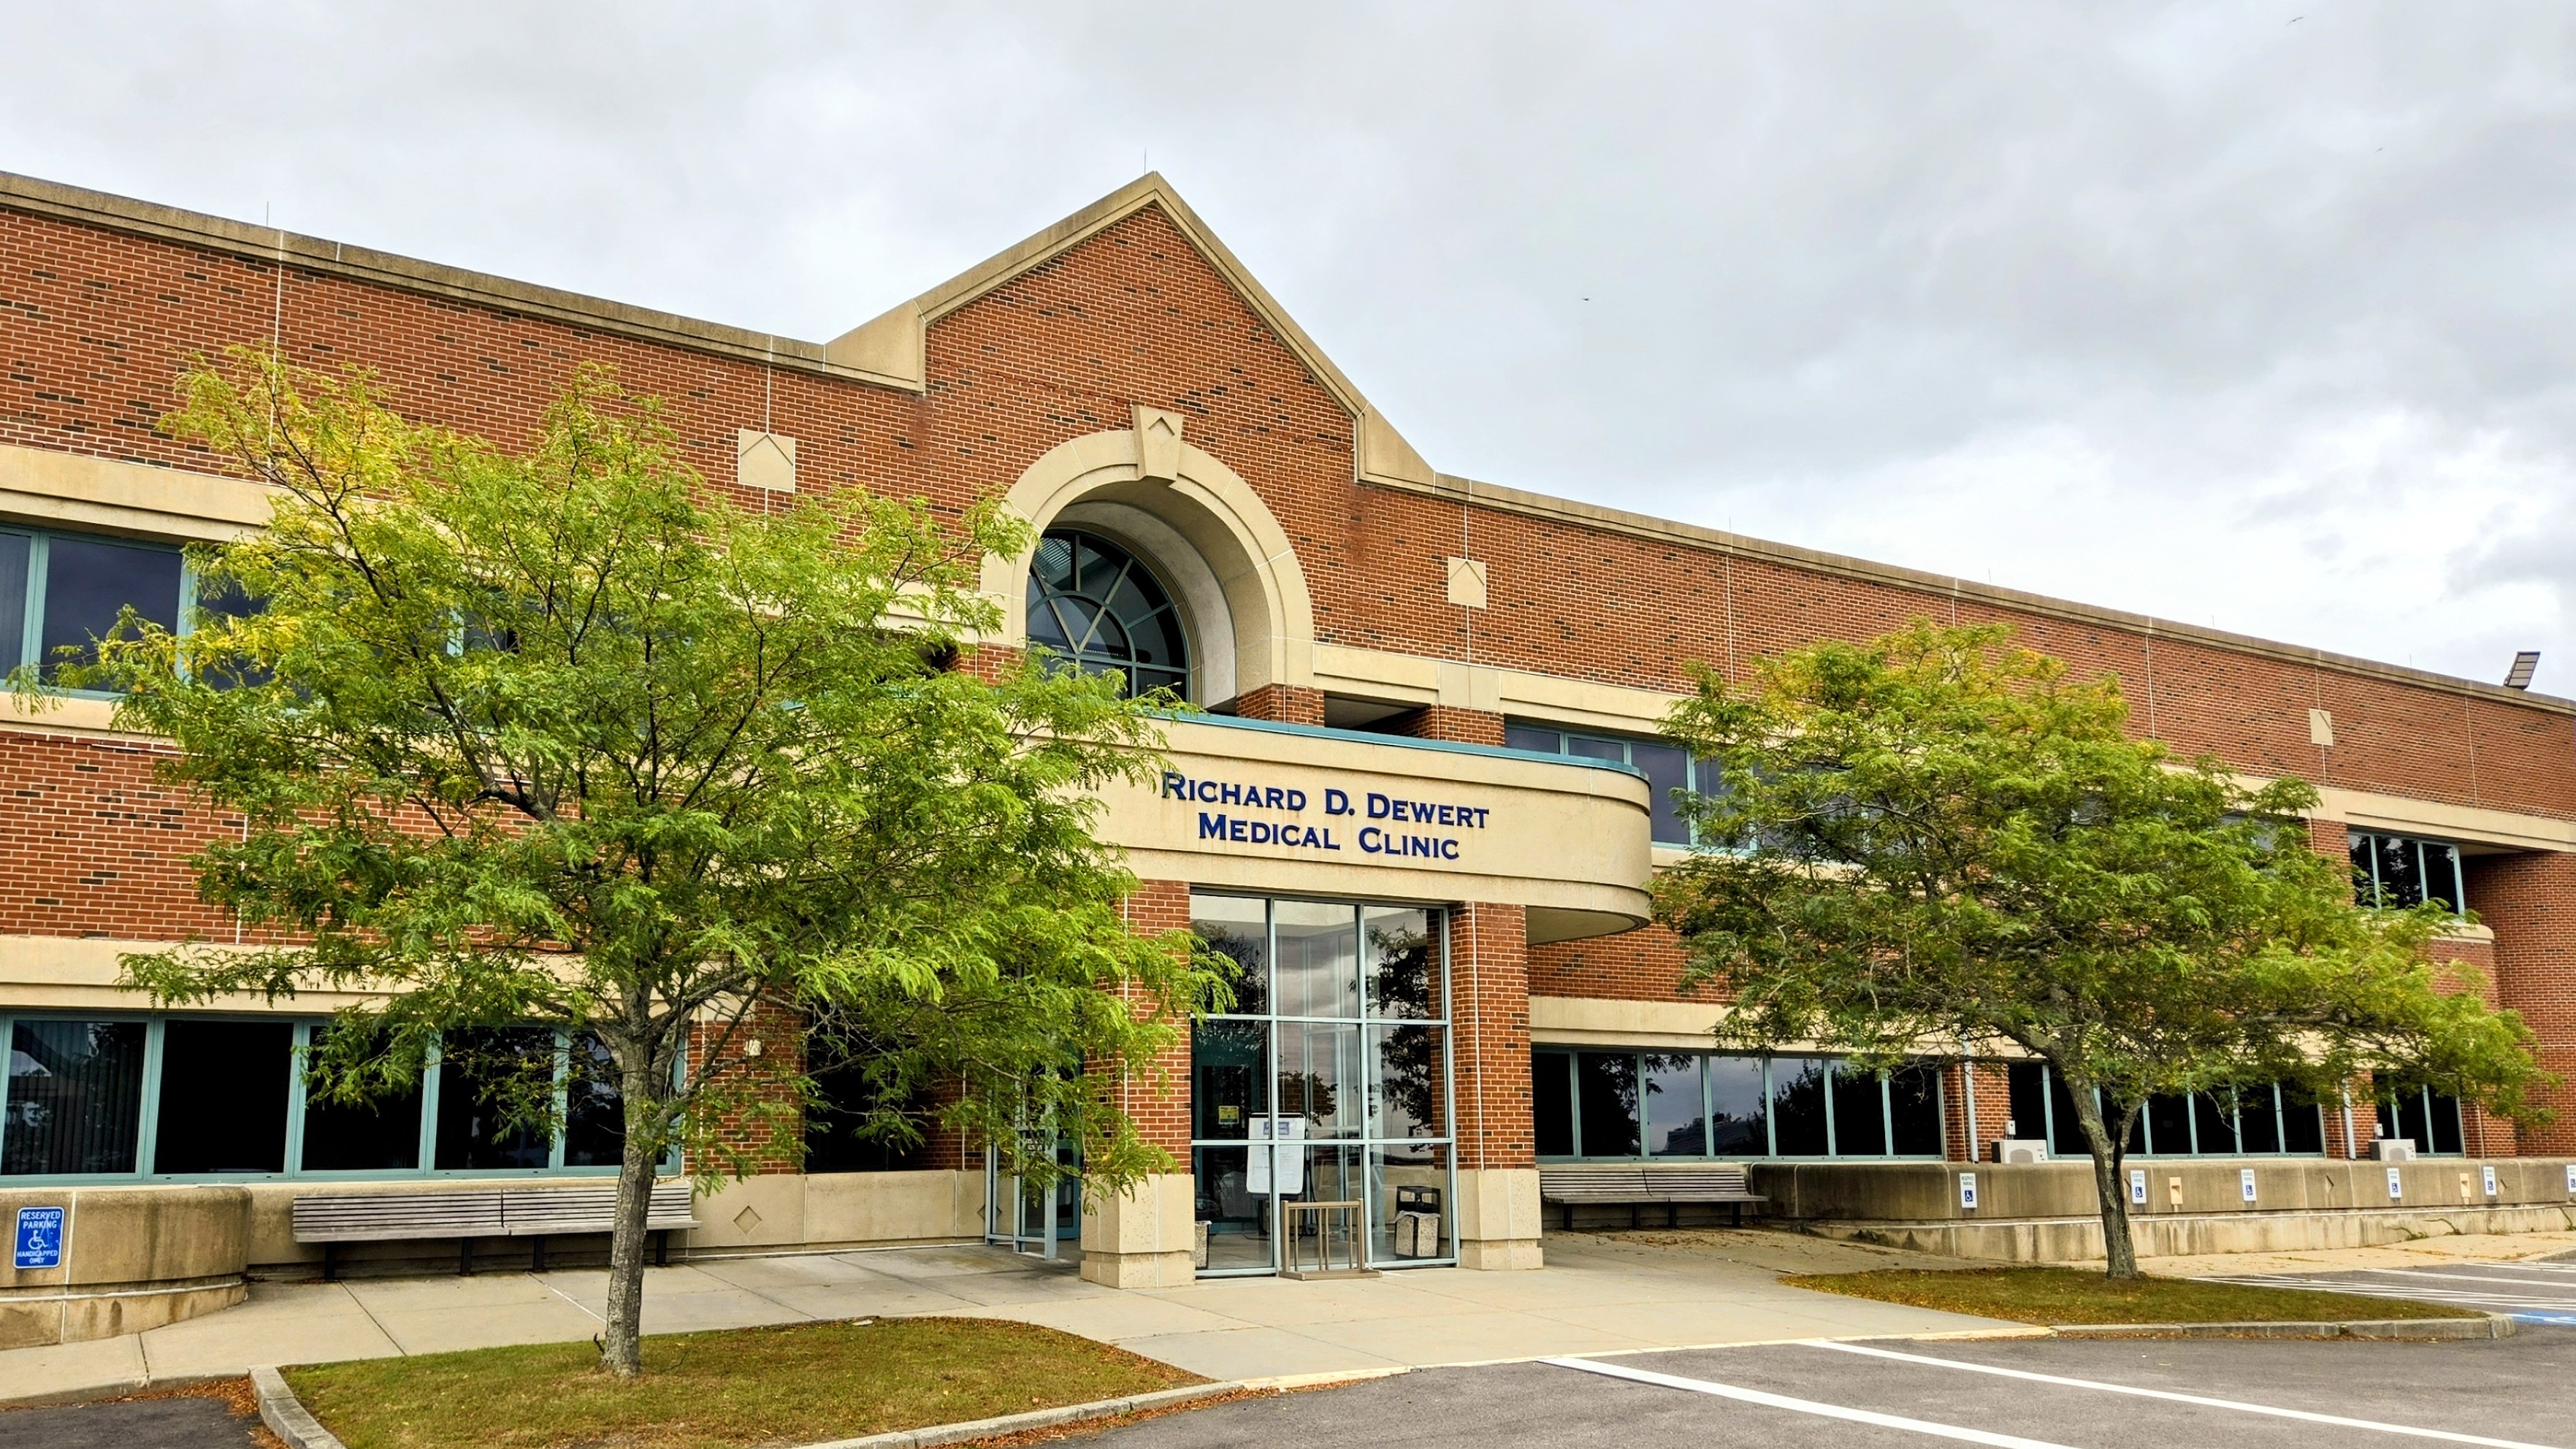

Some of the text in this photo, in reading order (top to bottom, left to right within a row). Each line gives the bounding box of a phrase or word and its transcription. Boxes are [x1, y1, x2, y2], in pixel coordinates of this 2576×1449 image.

[1161, 772, 1490, 829] RICHARD D. DEWERT
[1199, 812, 1460, 860] MEDICAL CLINIC
[20, 1211, 61, 1220] RESERVED
[23, 1220, 57, 1229] PARKING
[17, 1250, 58, 1258] HANDICAPPED
